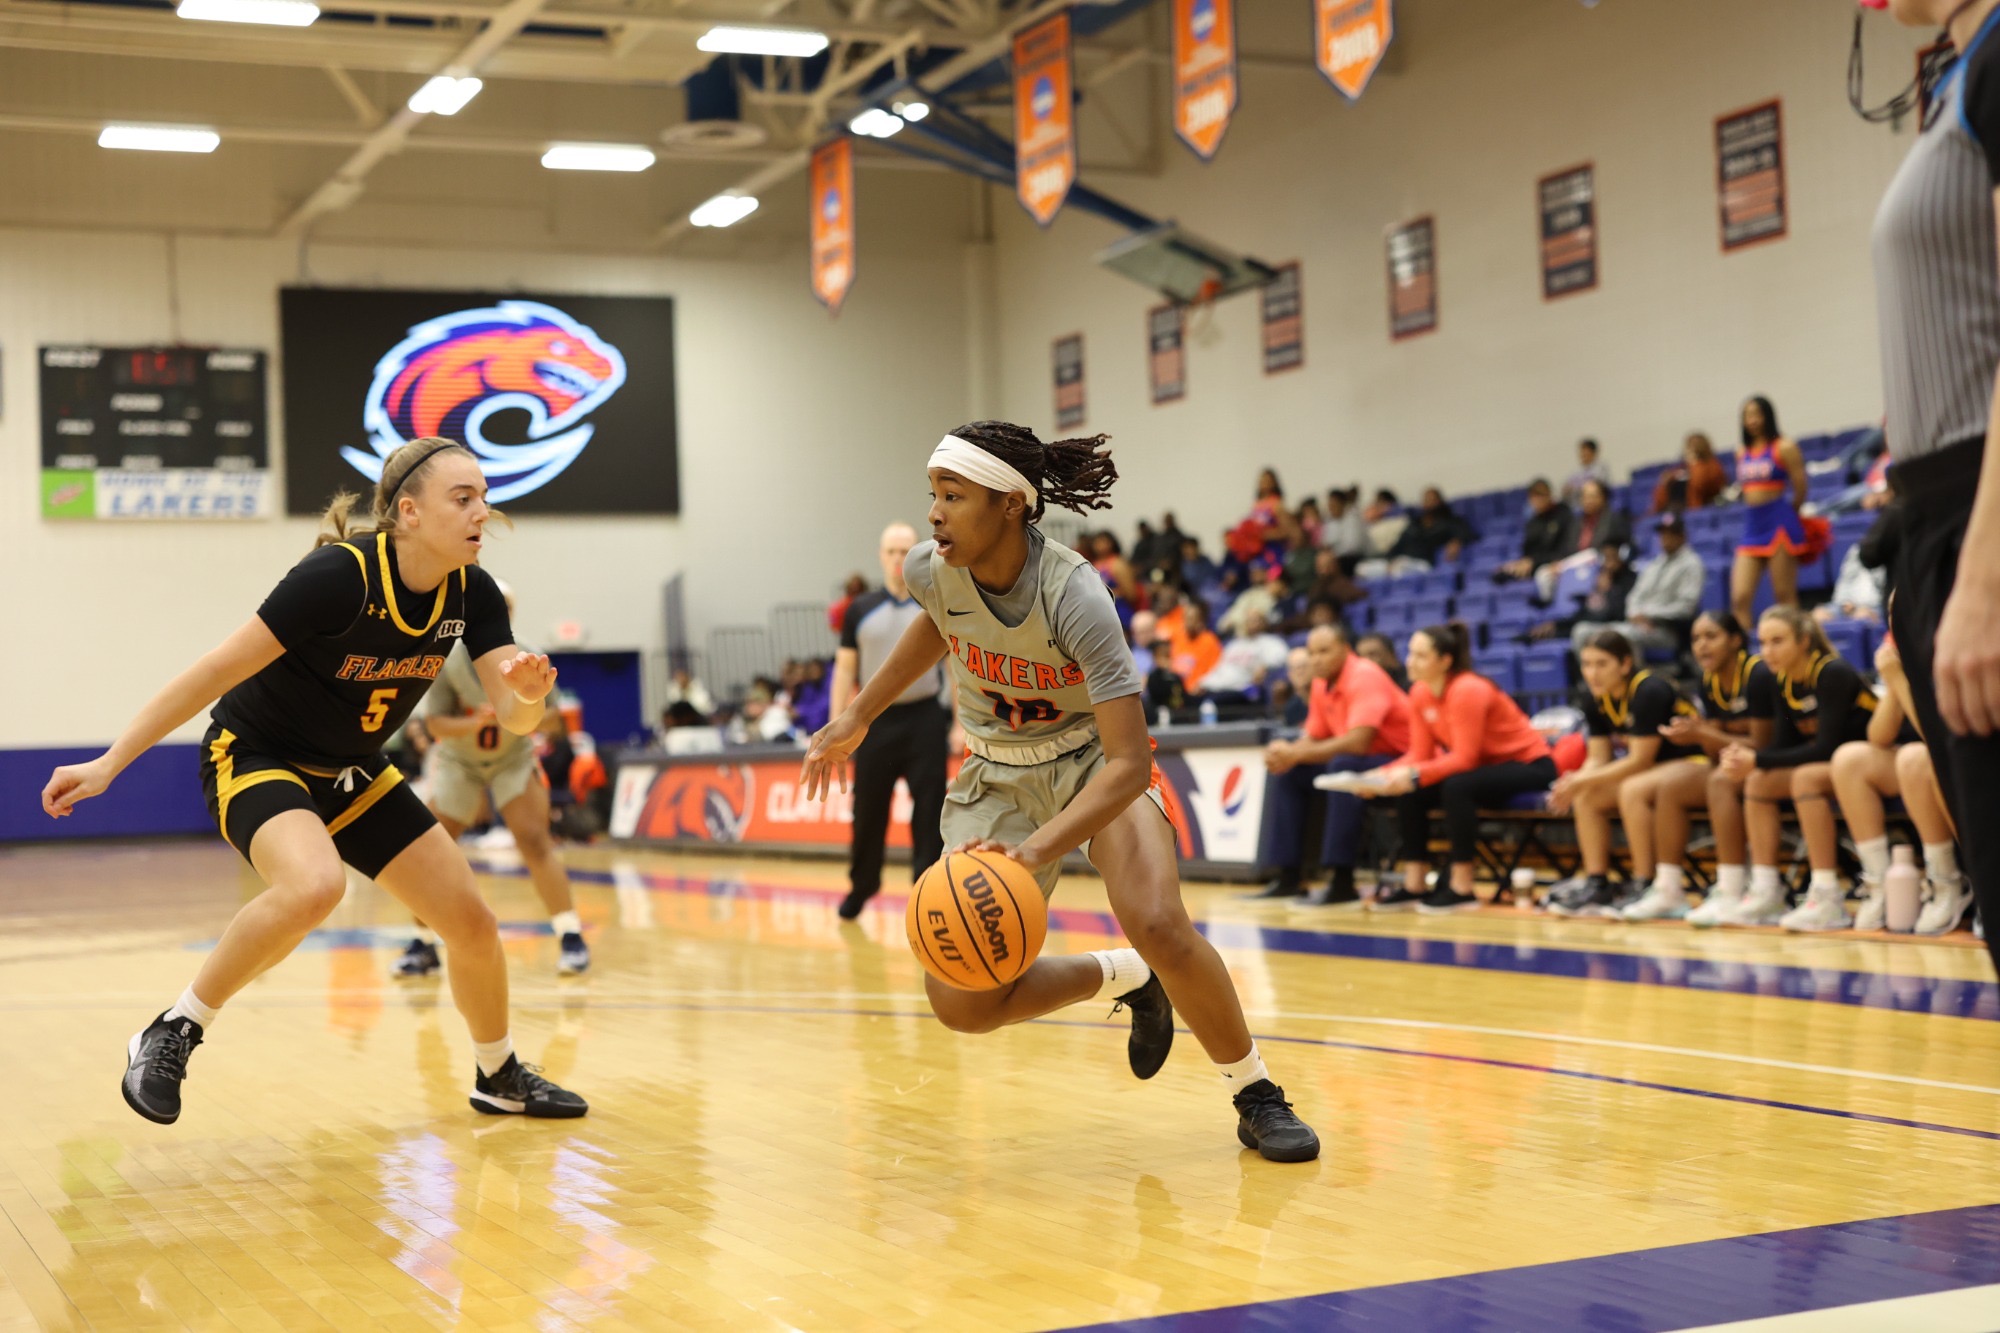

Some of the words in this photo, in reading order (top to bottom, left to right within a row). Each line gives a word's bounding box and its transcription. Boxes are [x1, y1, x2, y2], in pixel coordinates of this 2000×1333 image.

[434, 619, 466, 642] BC
[335, 654, 446, 681] FLAGLER
[360, 687, 399, 733] 5
[478, 725, 499, 751] 0
[963, 869, 1009, 967] Wilson
